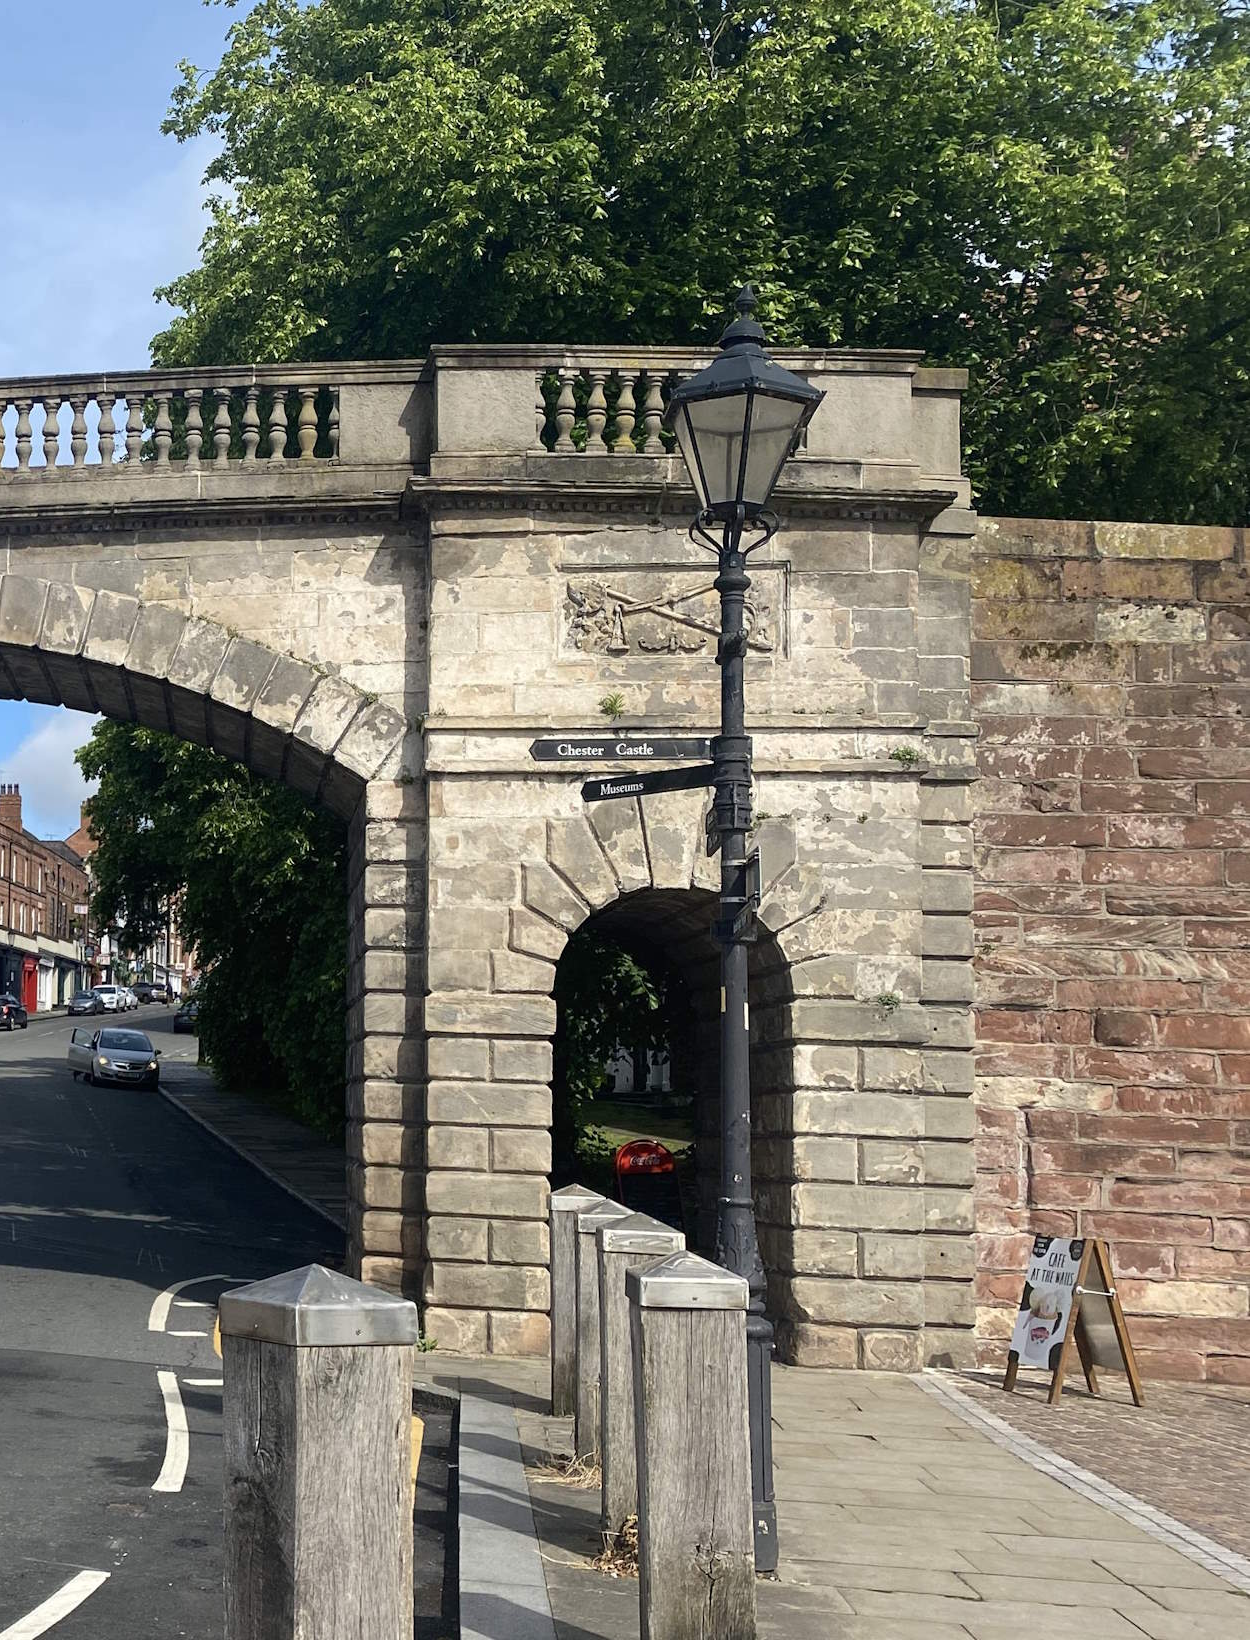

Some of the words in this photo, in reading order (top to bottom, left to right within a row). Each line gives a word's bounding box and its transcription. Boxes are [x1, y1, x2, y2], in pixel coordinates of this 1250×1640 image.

[557, 743, 604, 756] Chester
[615, 742, 654, 756] Castle
[600, 782, 644, 796] Museums
[1049, 1253, 1067, 1268] CAFE
[1031, 1268, 1040, 1281] AT
[1041, 1269, 1055, 1284] THE
